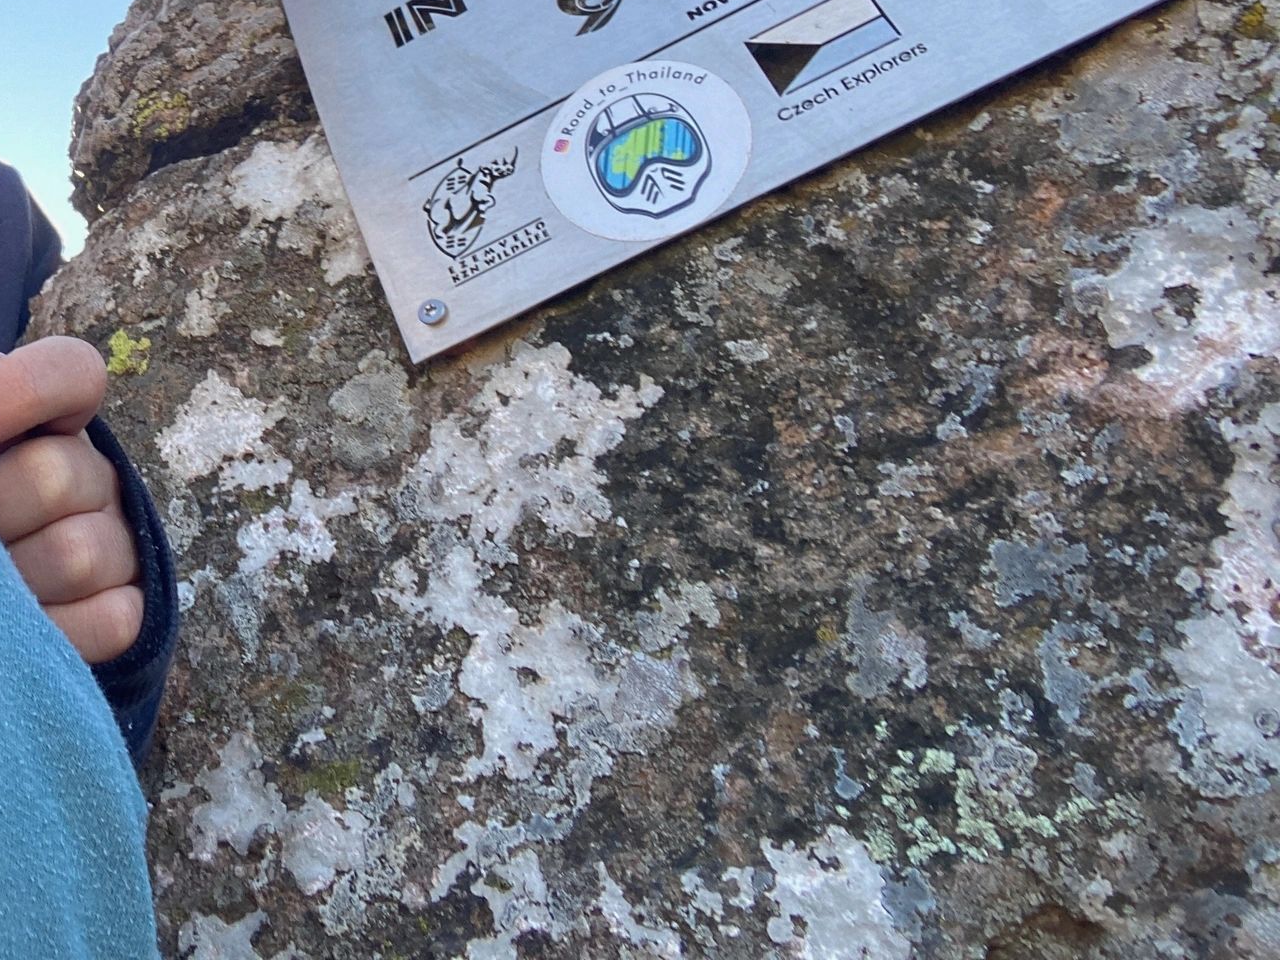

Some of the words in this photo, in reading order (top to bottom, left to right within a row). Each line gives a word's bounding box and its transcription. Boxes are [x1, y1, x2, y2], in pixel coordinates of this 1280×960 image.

[776, 84, 840, 122] Czech
[839, 43, 928, 92] Explorers
[448, 221, 545, 275] EZEMVELO
[451, 264, 480, 284] KZN
[483, 229, 550, 267] WILDLIFE
